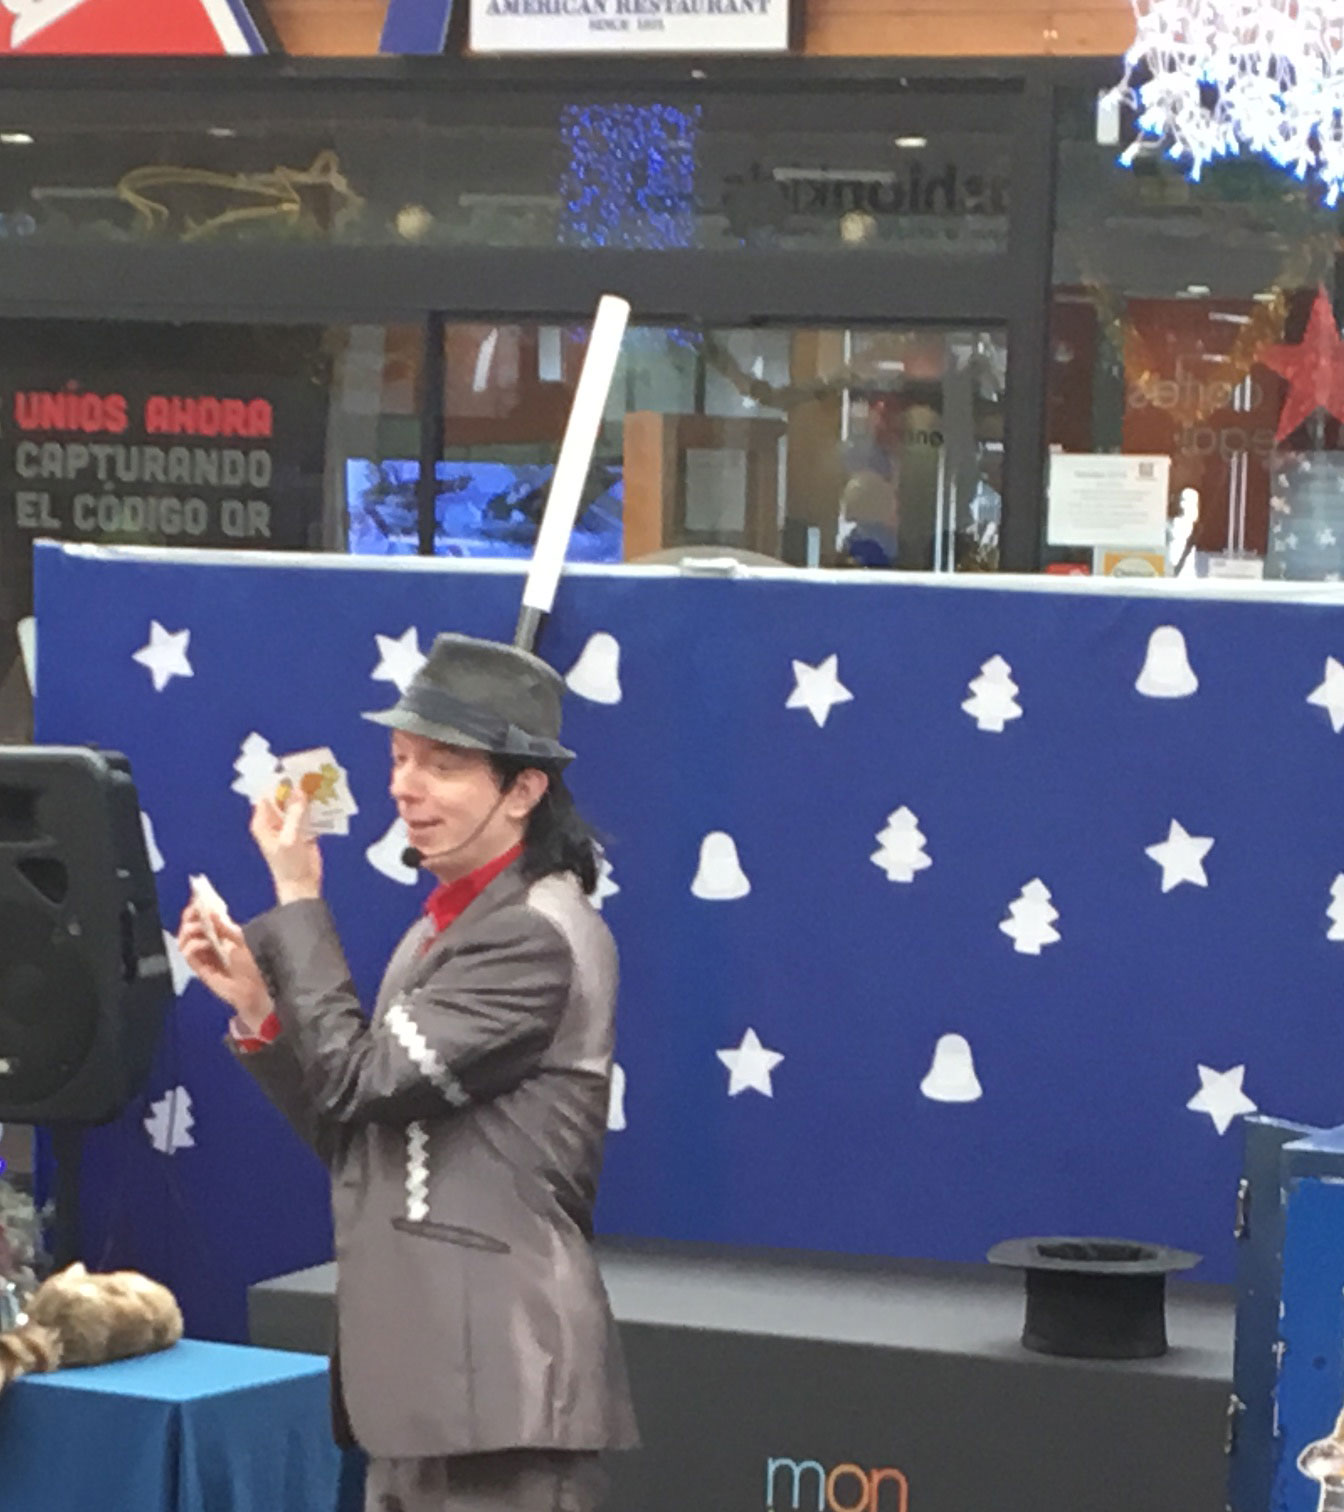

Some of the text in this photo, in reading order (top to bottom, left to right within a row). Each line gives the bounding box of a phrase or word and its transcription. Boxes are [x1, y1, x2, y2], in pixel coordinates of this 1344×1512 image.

[145, 396, 273, 437] AHORA
[15, 440, 272, 488] CAPTURANDO
[15, 481, 271, 538] EL CÓDIGO QR
